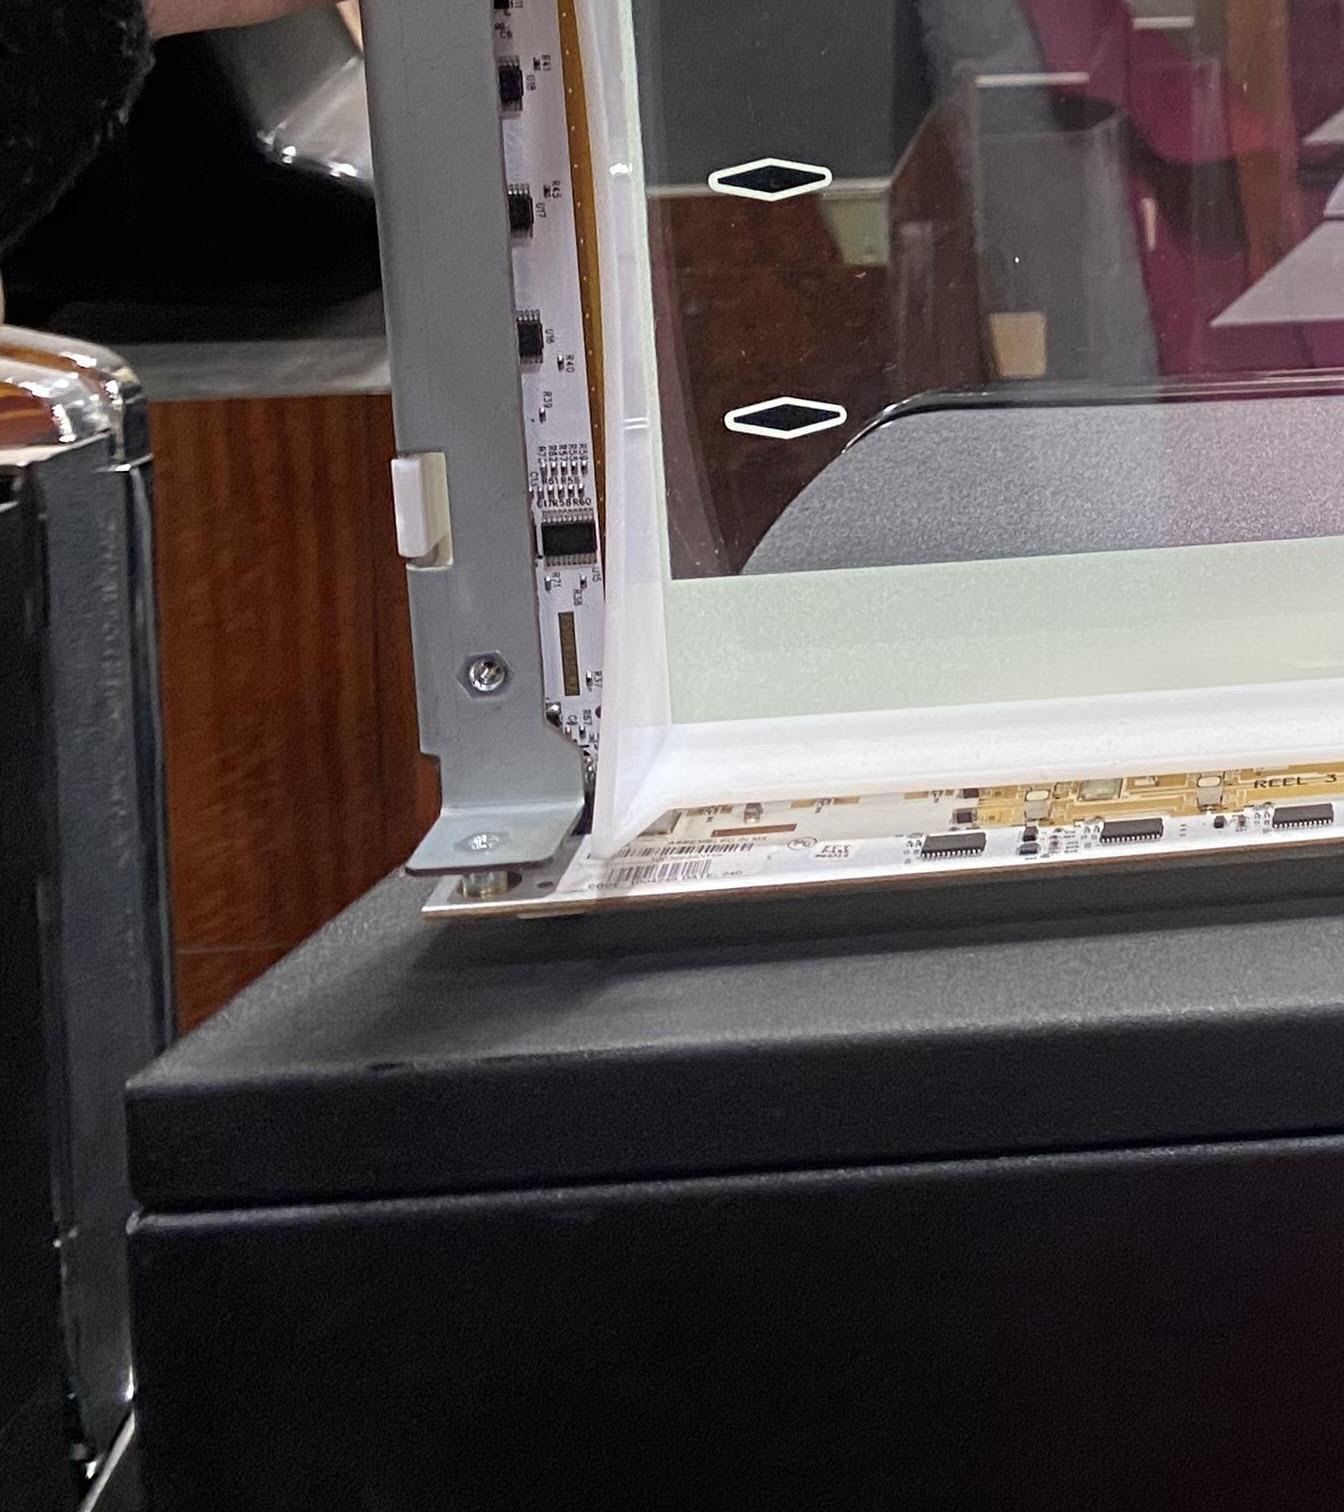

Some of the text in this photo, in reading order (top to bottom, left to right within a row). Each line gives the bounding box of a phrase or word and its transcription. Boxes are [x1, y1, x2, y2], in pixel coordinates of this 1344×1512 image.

[535, 202, 546, 218] U17
[564, 354, 576, 373] R40
[542, 391, 553, 409] R39
[1253, 773, 1337, 789] REEL 3
